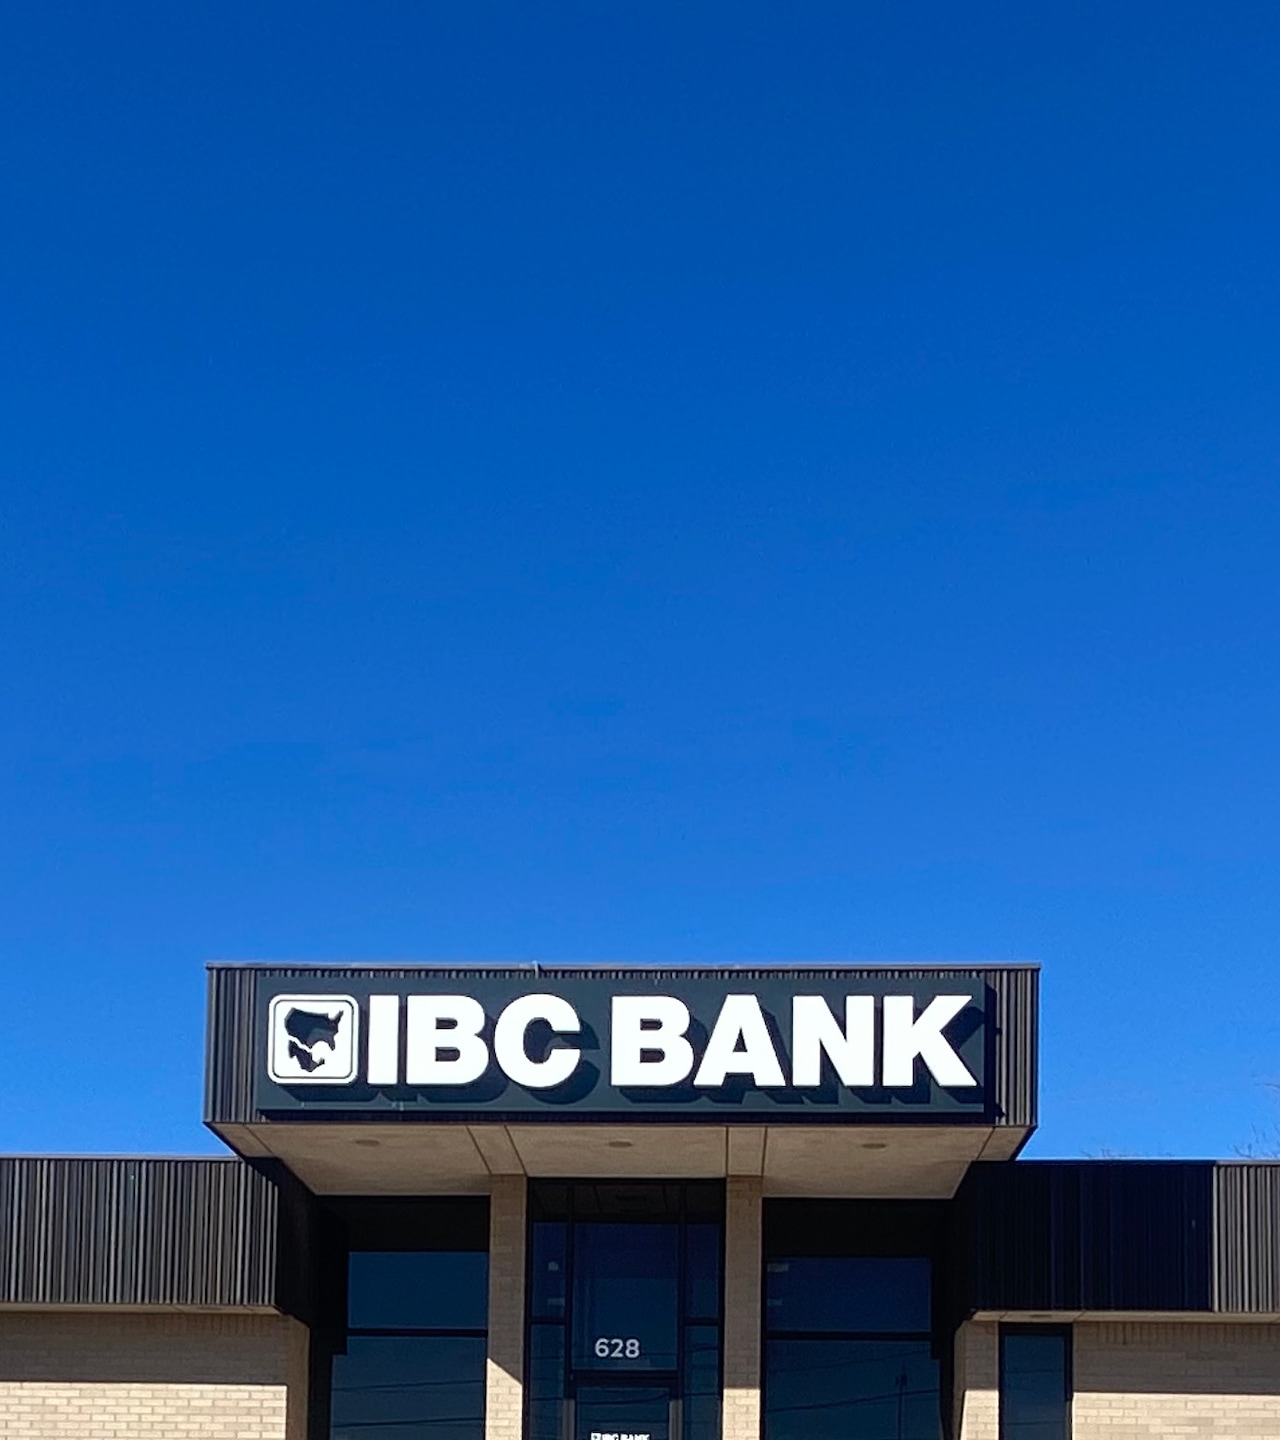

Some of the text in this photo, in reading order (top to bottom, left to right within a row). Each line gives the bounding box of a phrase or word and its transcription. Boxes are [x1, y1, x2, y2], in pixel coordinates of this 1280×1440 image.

[367, 993, 977, 1088] IBC BANK
[594, 1338, 640, 1358] 628
